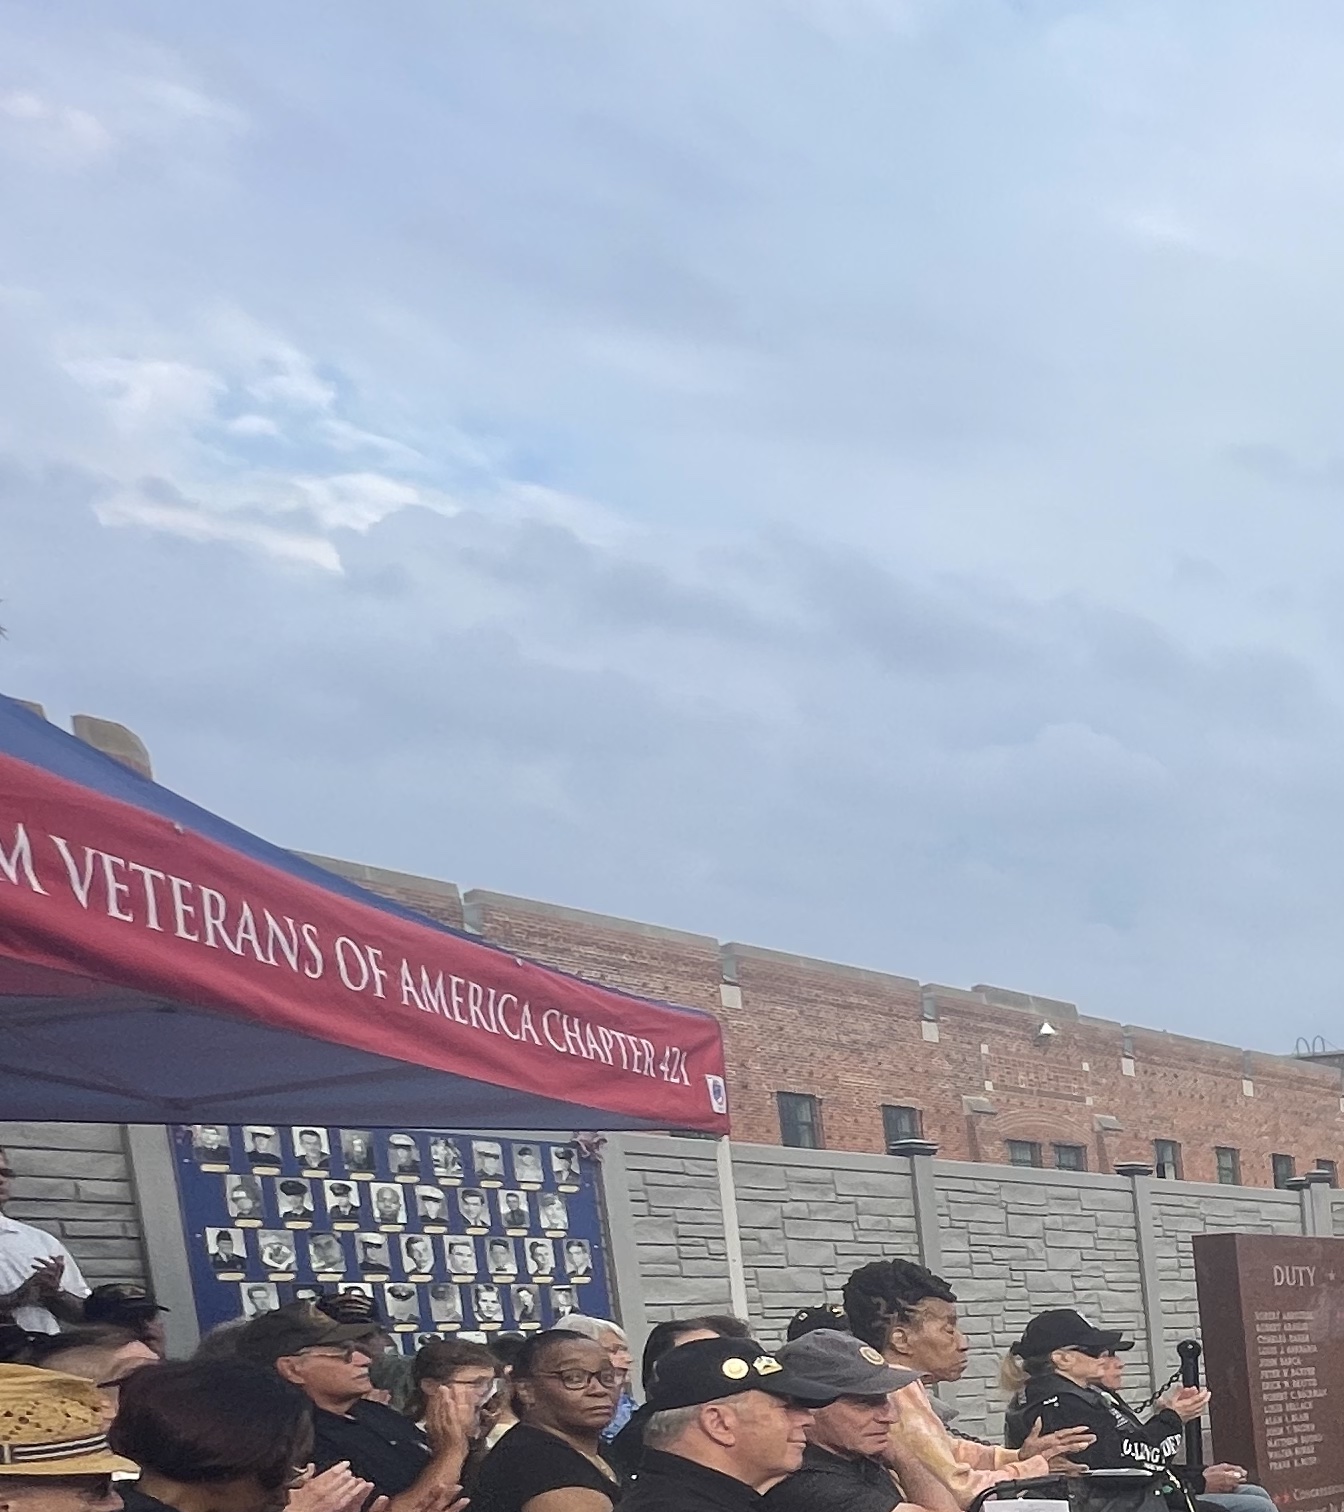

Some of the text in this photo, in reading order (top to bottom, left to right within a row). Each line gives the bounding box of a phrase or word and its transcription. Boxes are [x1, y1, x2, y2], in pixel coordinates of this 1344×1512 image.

[49, 834, 324, 979] VETERANS
[334, 935, 388, 999] OF
[400, 957, 543, 1046] AMERICA
[542, 1008, 656, 1078] CHAPTER
[659, 1046, 692, 1086] 421
[1273, 1264, 1317, 1287] DUTY
